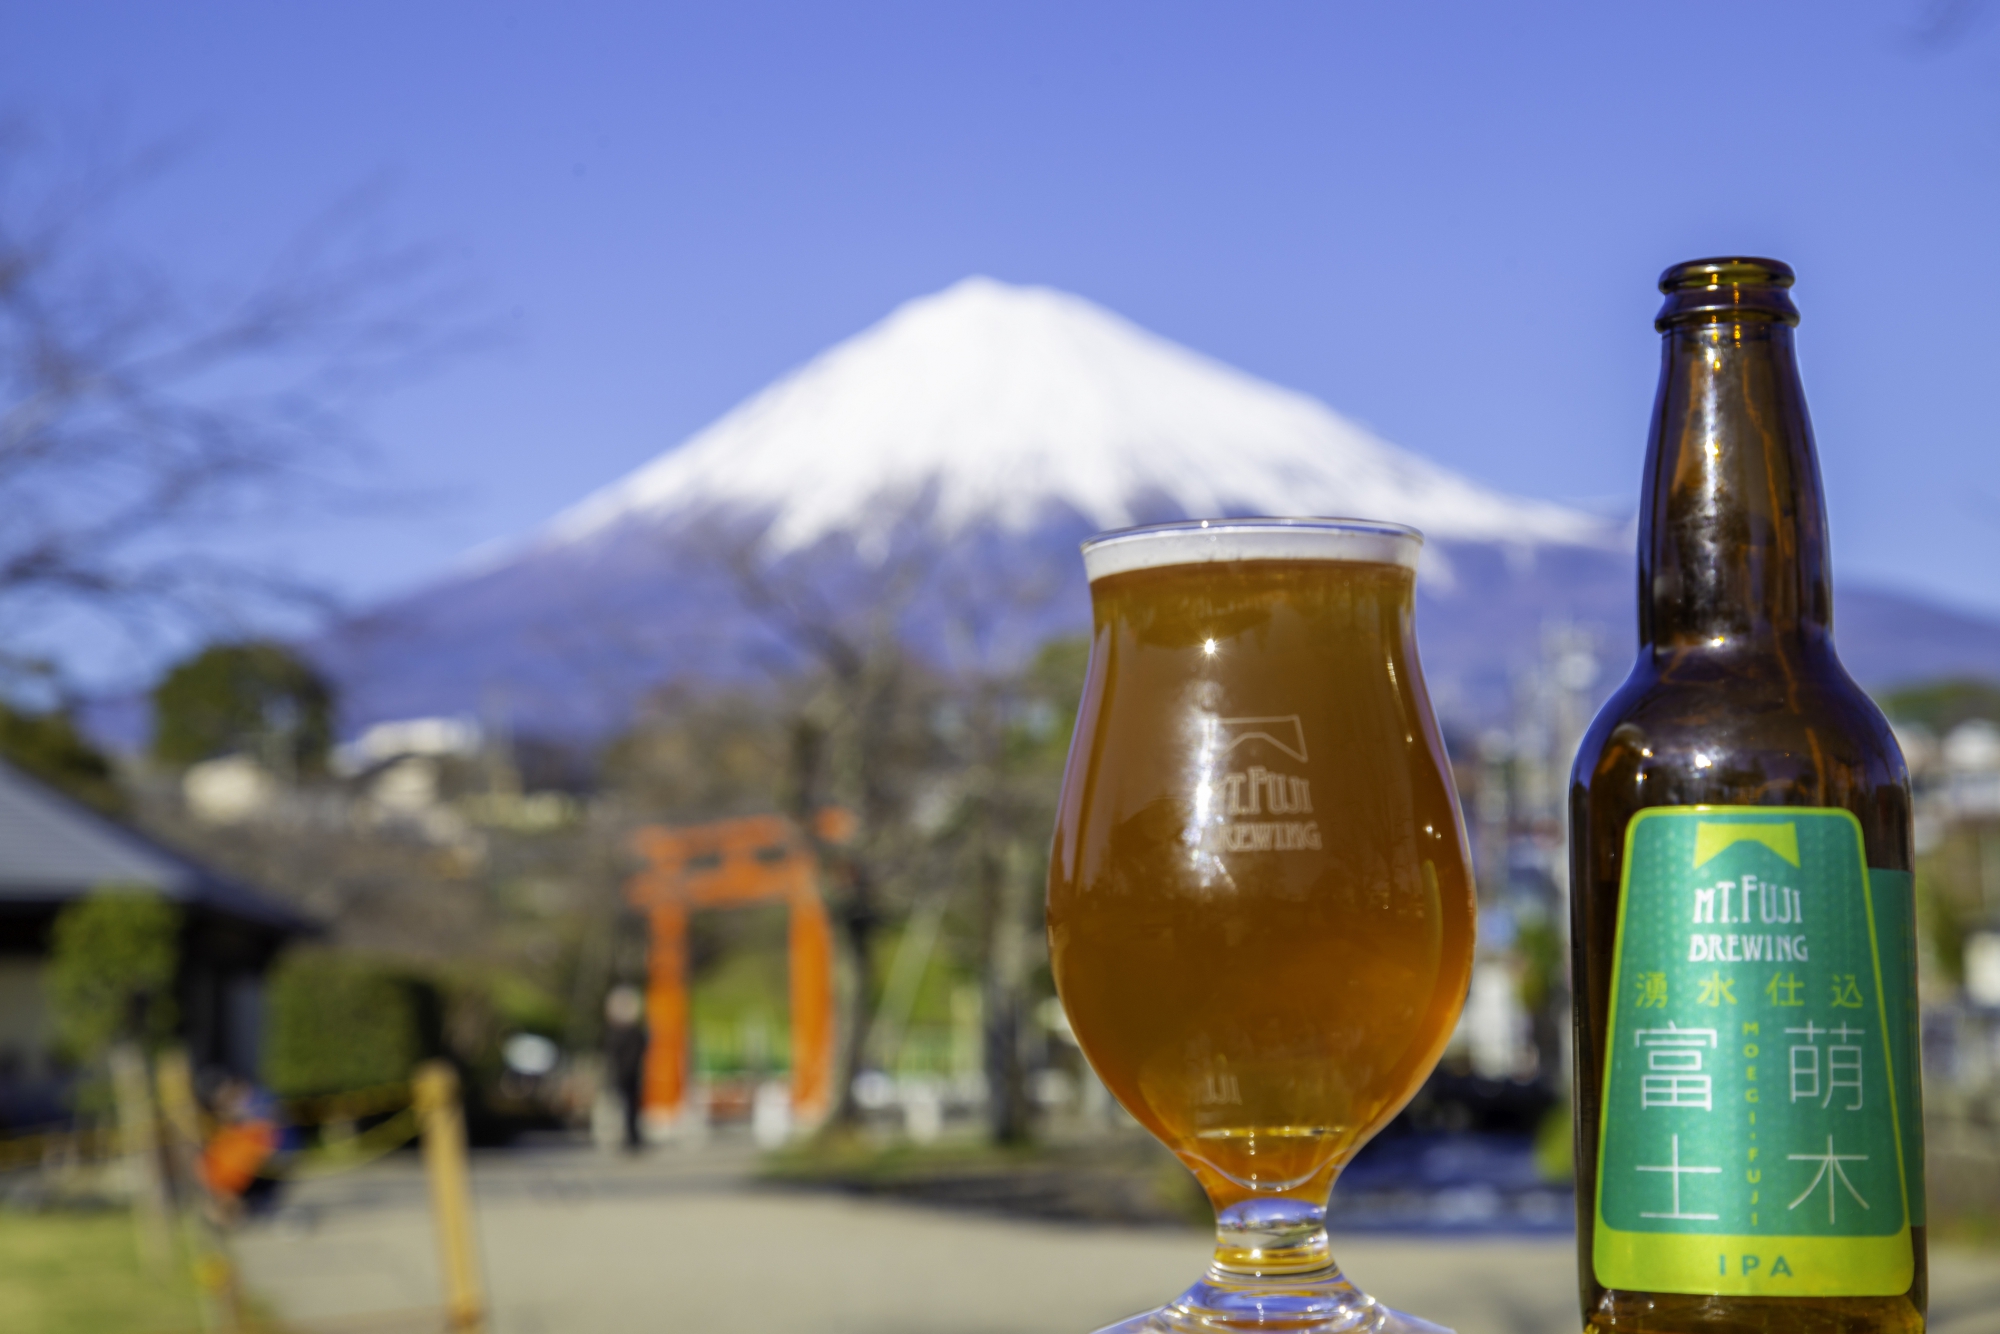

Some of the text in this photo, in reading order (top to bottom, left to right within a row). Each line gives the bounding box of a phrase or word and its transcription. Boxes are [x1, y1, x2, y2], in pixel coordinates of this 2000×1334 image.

[1201, 821, 1322, 851] REWING
[1688, 933, 1808, 962] BREWING
[1634, 970, 1863, 1009] 湧水仕込
[1634, 1020, 1722, 1220] 富士
[1784, 1019, 1869, 1225] 萌木
[1719, 1254, 1794, 1278] IPA
